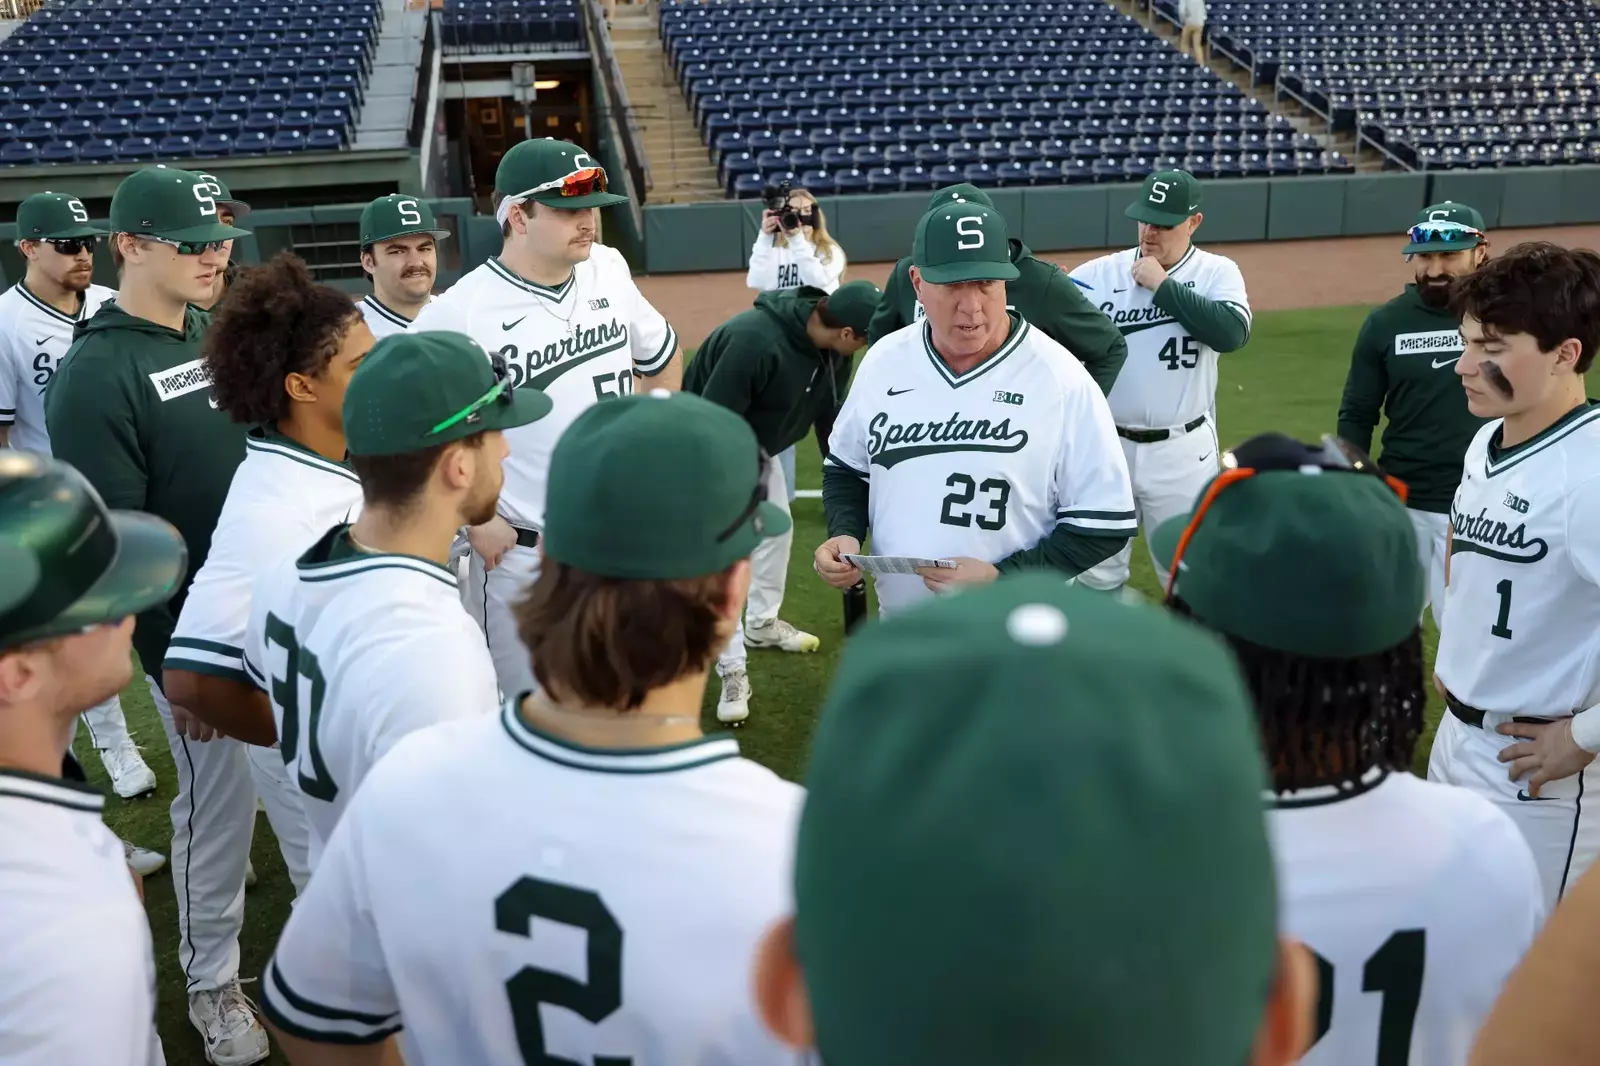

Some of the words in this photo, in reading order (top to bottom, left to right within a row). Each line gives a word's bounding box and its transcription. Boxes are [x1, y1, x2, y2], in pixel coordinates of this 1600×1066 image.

[193, 183, 217, 216] S
[1149, 181, 1170, 204] S
[68, 200, 88, 222] S
[397, 200, 421, 226] S
[956, 216, 984, 250] S
[777, 263, 805, 288] PAR
[500, 317, 628, 391] Spartans
[1158, 336, 1200, 370] 45
[1400, 335, 1459, 351] MICHIGAN
[867, 412, 1029, 458] Spartans
[940, 472, 1011, 531] 23
[1491, 579, 1513, 640] 1
[493, 873, 632, 1066] 2
